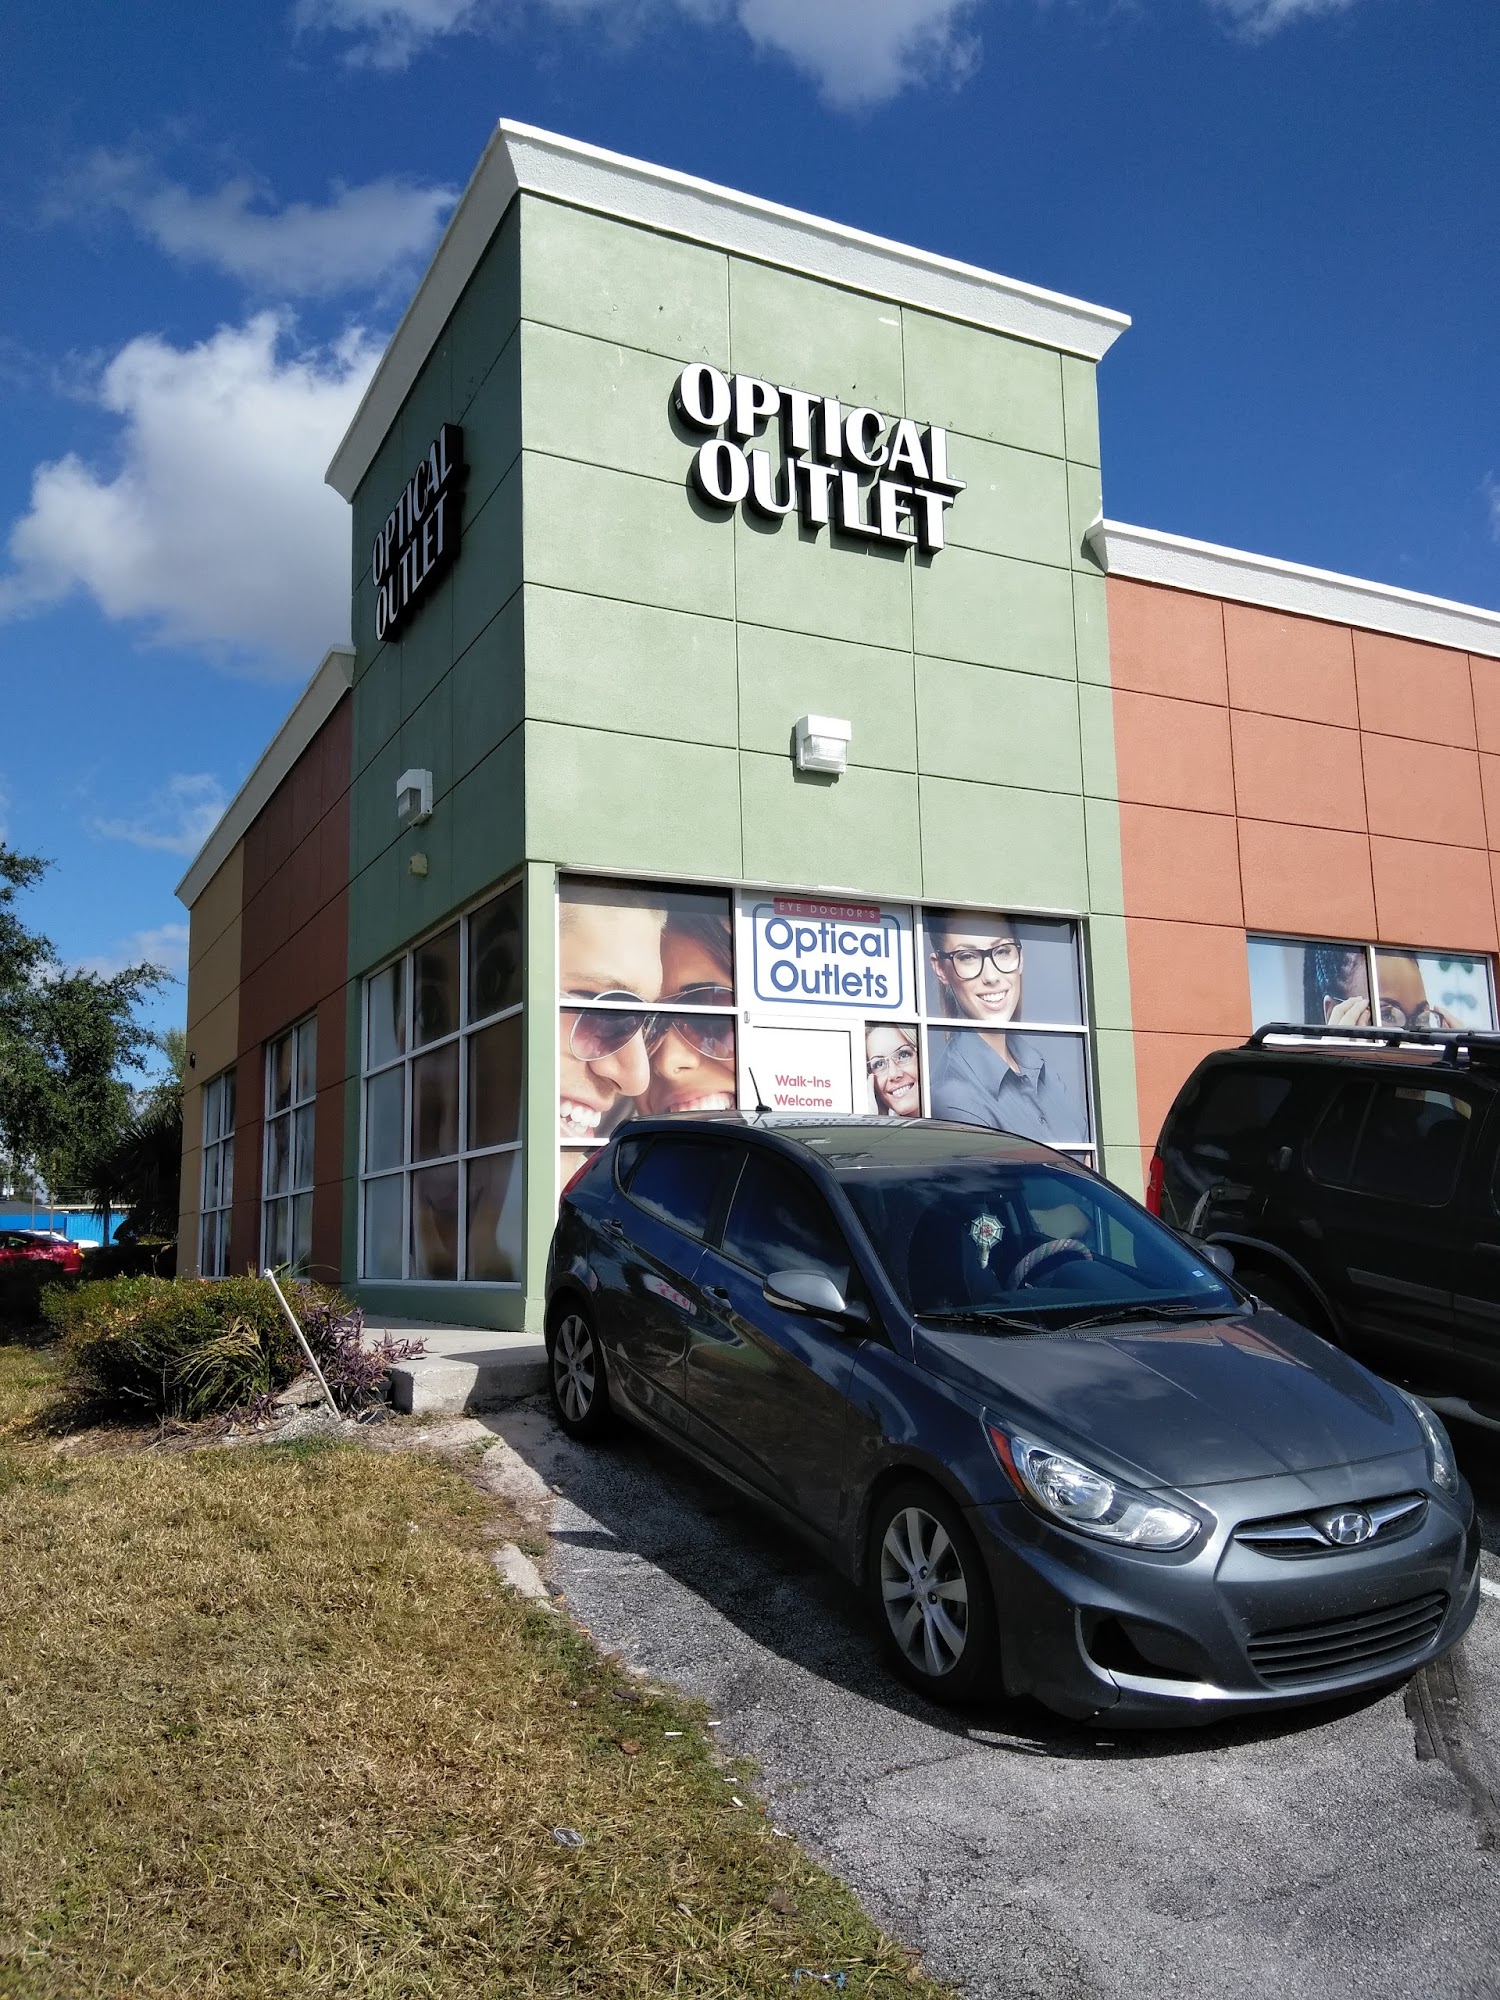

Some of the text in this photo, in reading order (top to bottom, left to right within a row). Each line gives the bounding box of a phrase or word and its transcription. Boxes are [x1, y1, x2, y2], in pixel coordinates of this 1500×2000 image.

[680, 362, 967, 489] OPTICAL
[373, 424, 452, 586] OPTICAL
[698, 438, 954, 550] OUTLET
[376, 491, 447, 640] OUTLET
[779, 902, 875, 918] EYE DOCTOR'S
[765, 918, 889, 958] Optical
[770, 960, 888, 998] Outlets
[774, 1094, 833, 1107] Welcome
[775, 1074, 831, 1088] Walk-Ins
